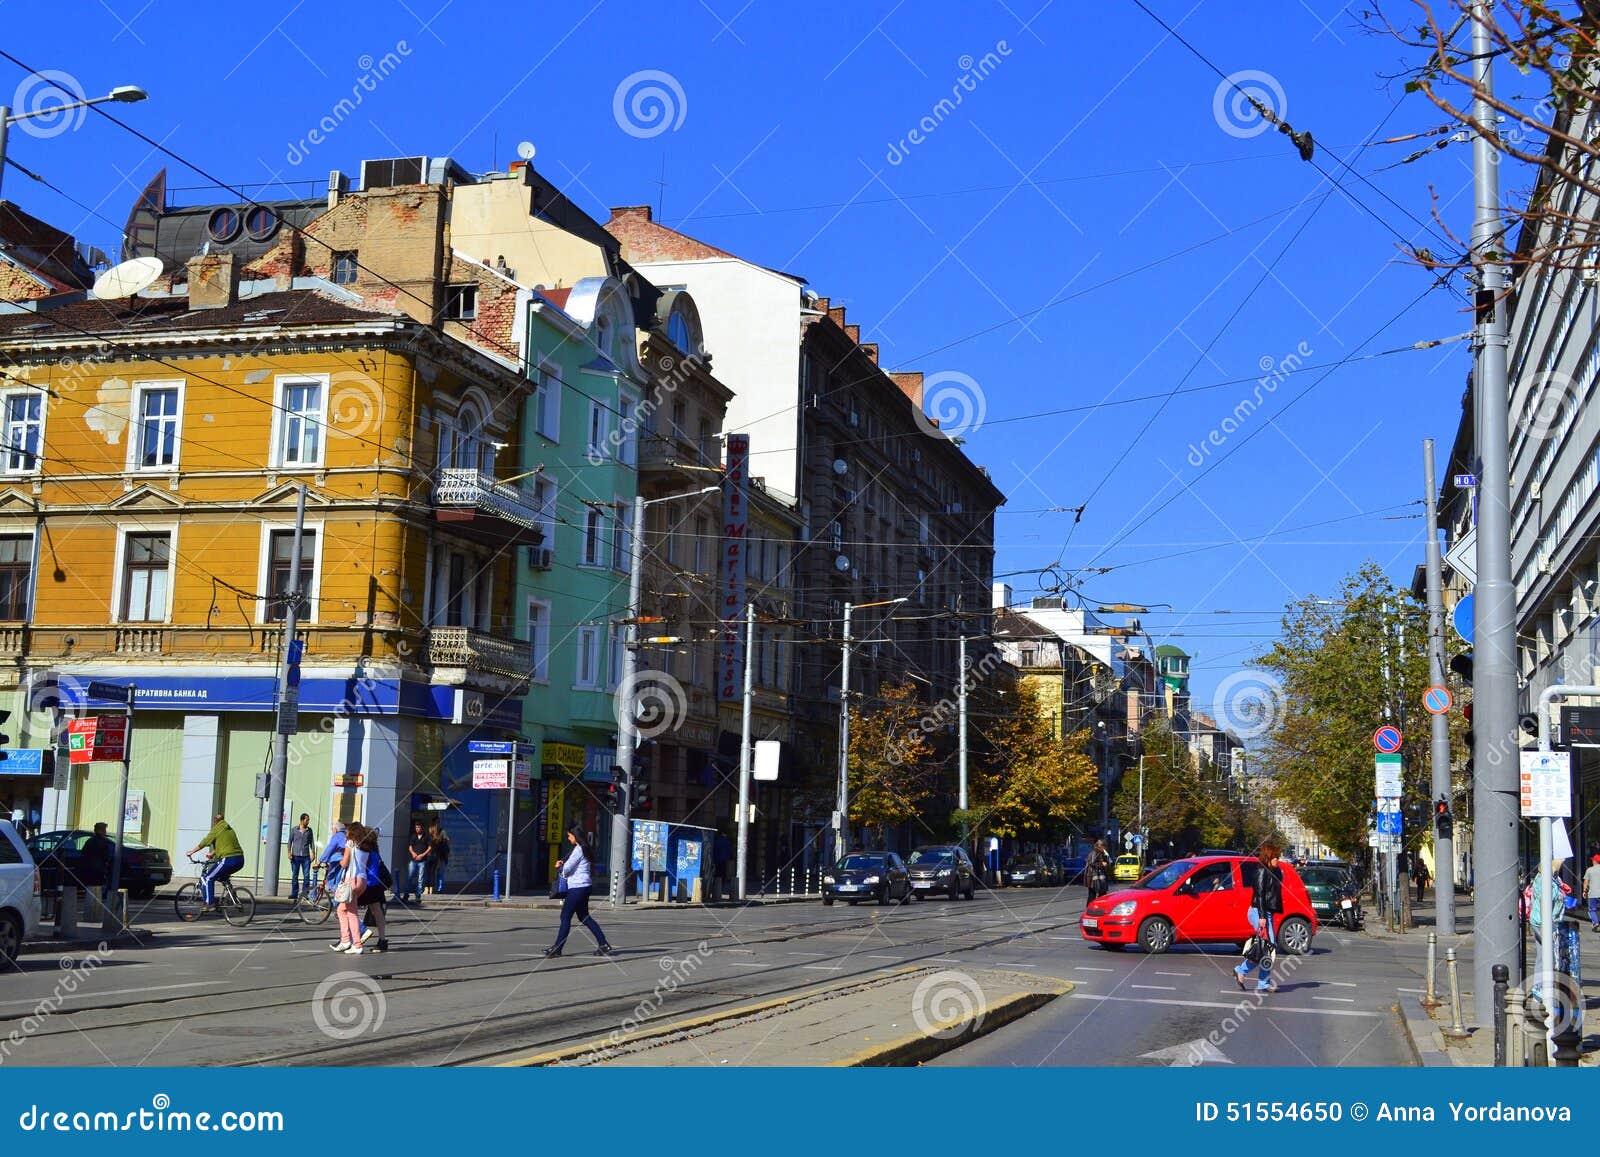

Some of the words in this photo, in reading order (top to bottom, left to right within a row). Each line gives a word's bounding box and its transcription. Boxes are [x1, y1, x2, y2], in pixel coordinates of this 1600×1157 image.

[724, 523, 745, 606] Maria
[174, 690, 196, 698] БАНКА
[198, 690, 208, 699] АД
